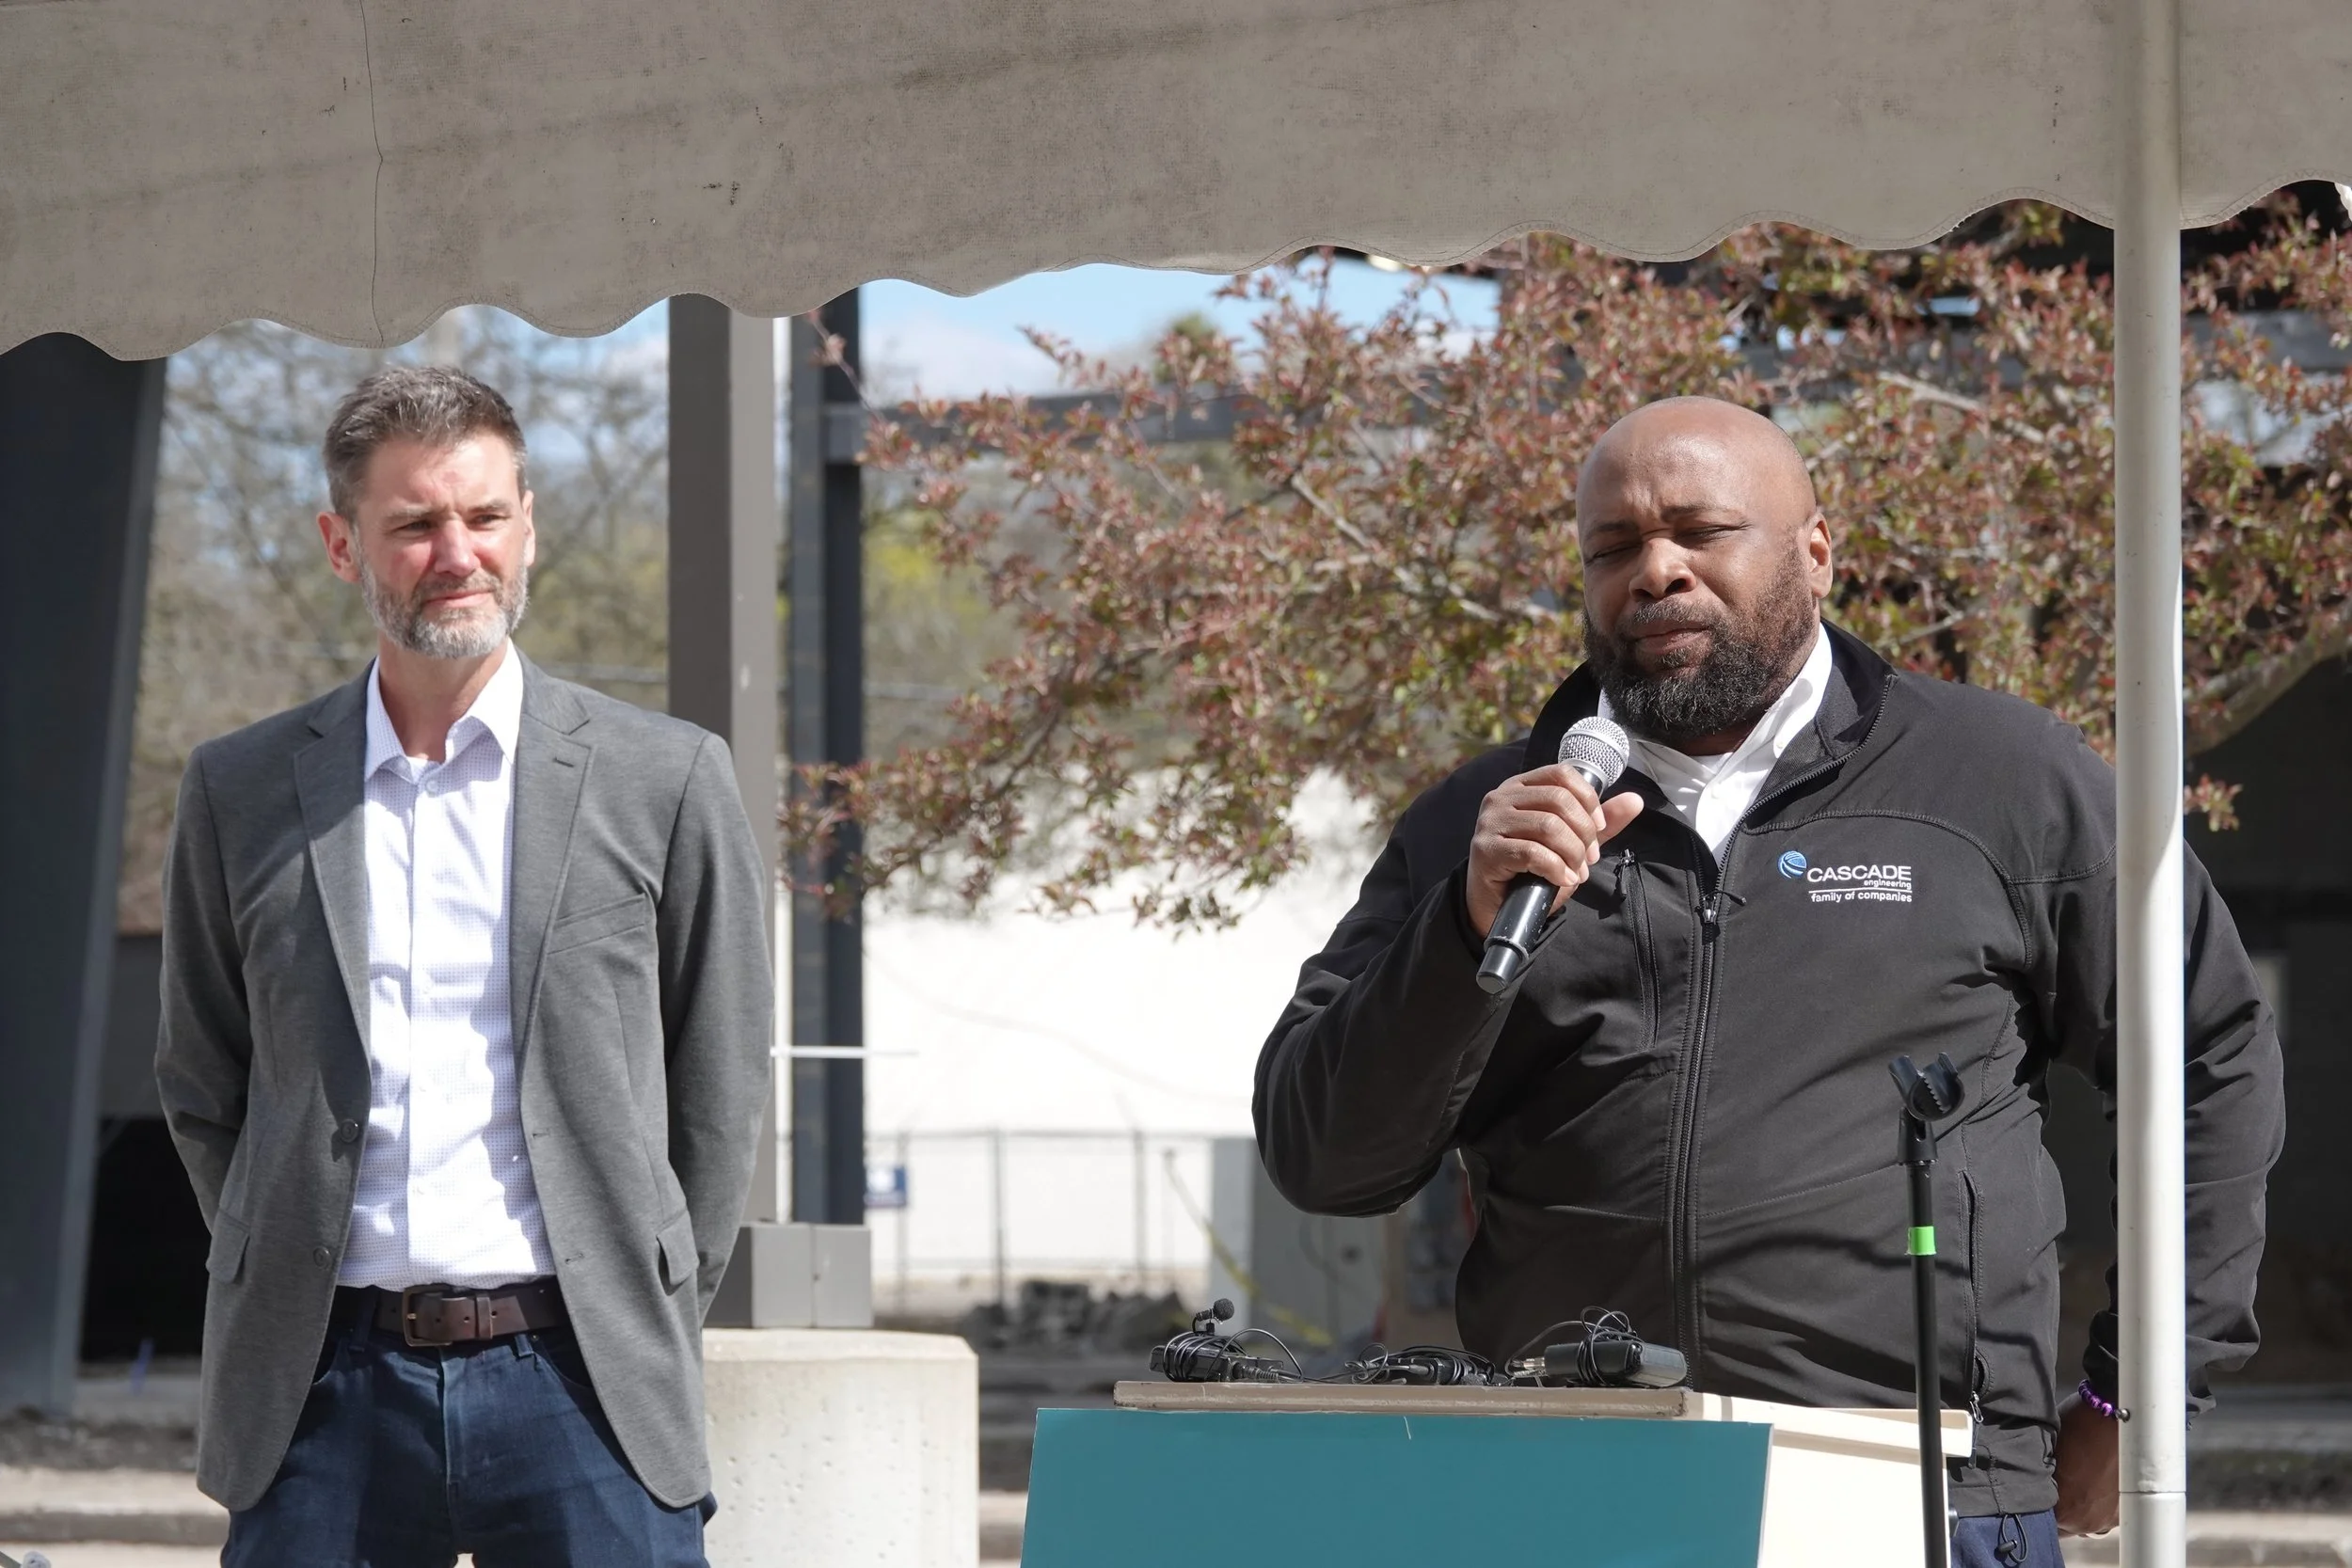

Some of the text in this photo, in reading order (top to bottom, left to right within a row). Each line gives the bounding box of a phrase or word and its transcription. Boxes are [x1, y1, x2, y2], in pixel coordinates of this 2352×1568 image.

[1807, 864, 1912, 882] CASCADE
[1864, 879, 1912, 890] engineering
[1811, 891, 1913, 903] family of companies
